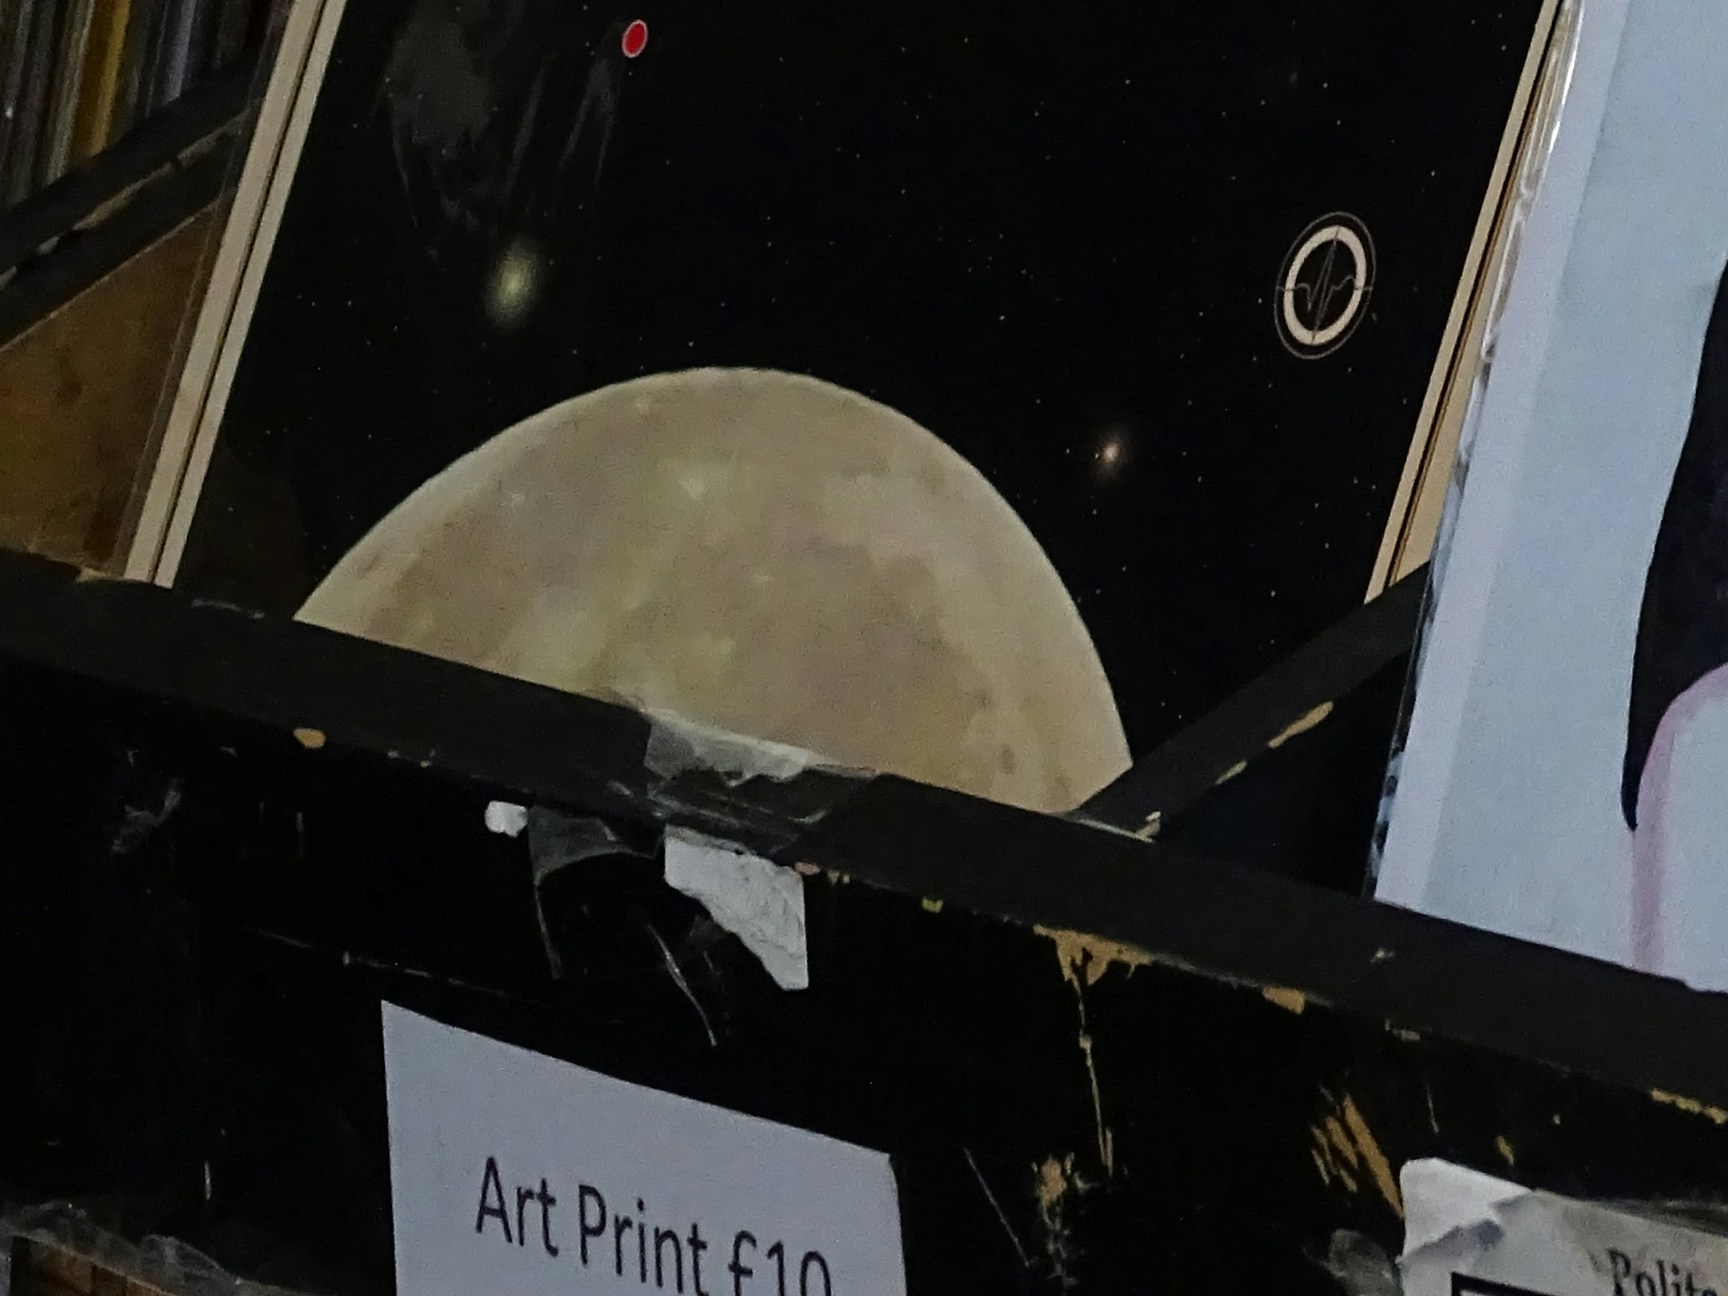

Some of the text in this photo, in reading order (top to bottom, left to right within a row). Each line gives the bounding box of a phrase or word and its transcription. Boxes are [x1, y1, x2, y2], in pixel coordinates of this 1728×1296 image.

[476, 1156, 832, 1296] Art Print £10
[1606, 1247, 1718, 1296] Polit
